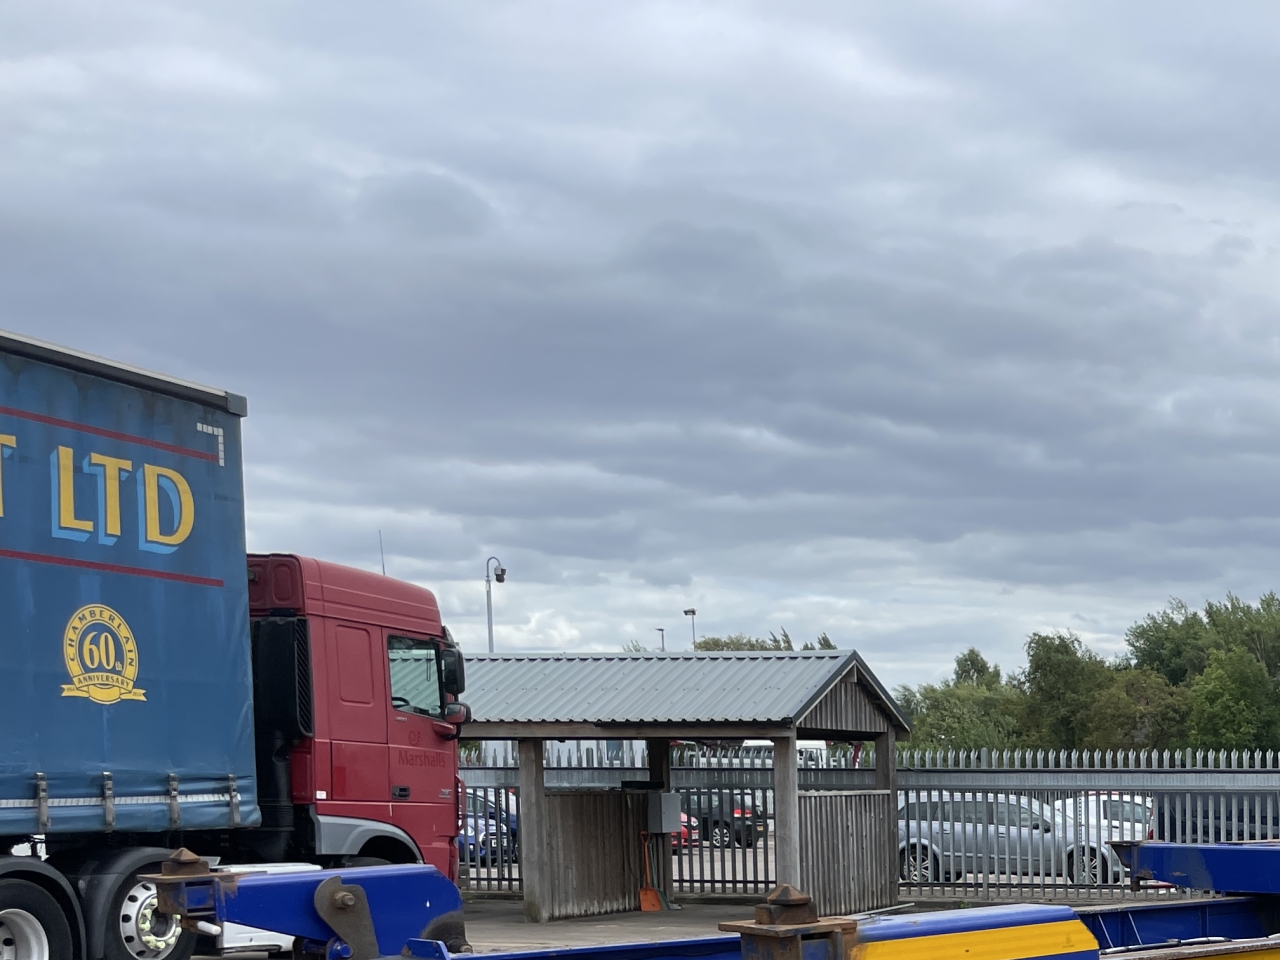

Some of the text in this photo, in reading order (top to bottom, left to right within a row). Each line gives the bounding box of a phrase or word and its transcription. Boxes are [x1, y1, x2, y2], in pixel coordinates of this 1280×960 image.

[50, 445, 195, 554] LTD
[67, 609, 135, 667] CHAMBERLAIN
[77, 673, 131, 689] ANNIVERSARY
[398, 750, 446, 768] Marshalls
